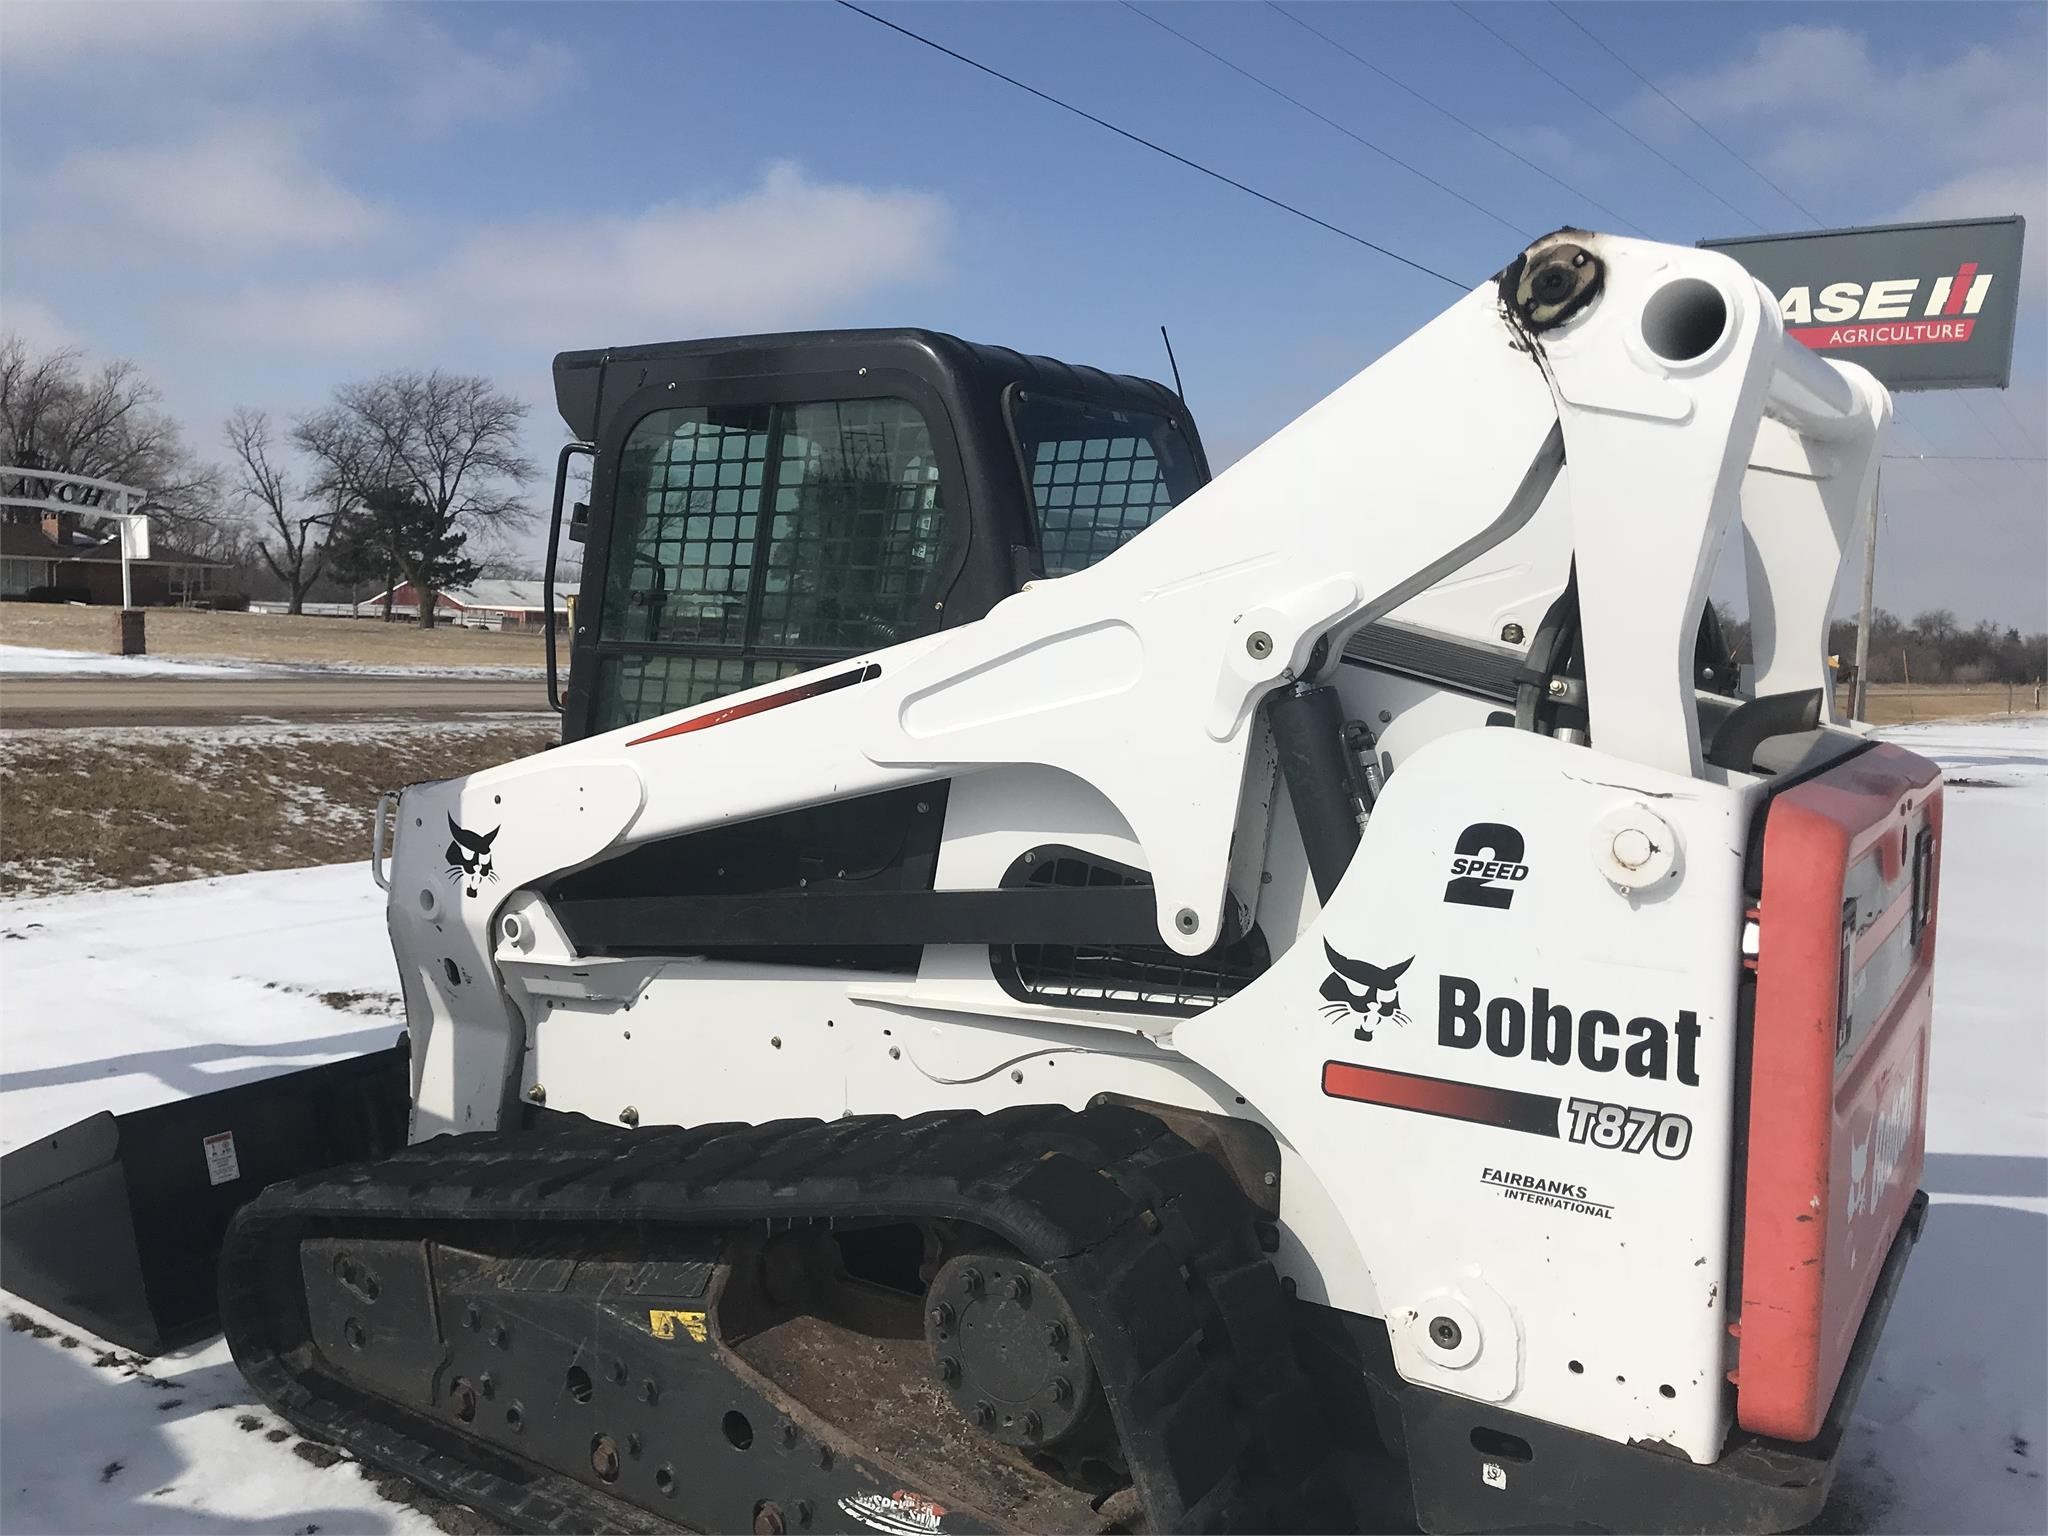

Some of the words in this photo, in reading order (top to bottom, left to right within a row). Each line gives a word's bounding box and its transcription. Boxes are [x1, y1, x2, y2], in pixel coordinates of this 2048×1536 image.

[1779, 279, 1920, 324] ASE
[1829, 323, 1966, 345] AGRICULTURE
[1443, 822, 1525, 910] 2
[1450, 858, 1529, 881] SPEED
[1438, 974, 1701, 1087] Bobcat
[1567, 1097, 1693, 1161] T870
[1481, 1167, 1588, 1199] FAIRBANKS
[1504, 1188, 1612, 1220] INTERNATIONAL
